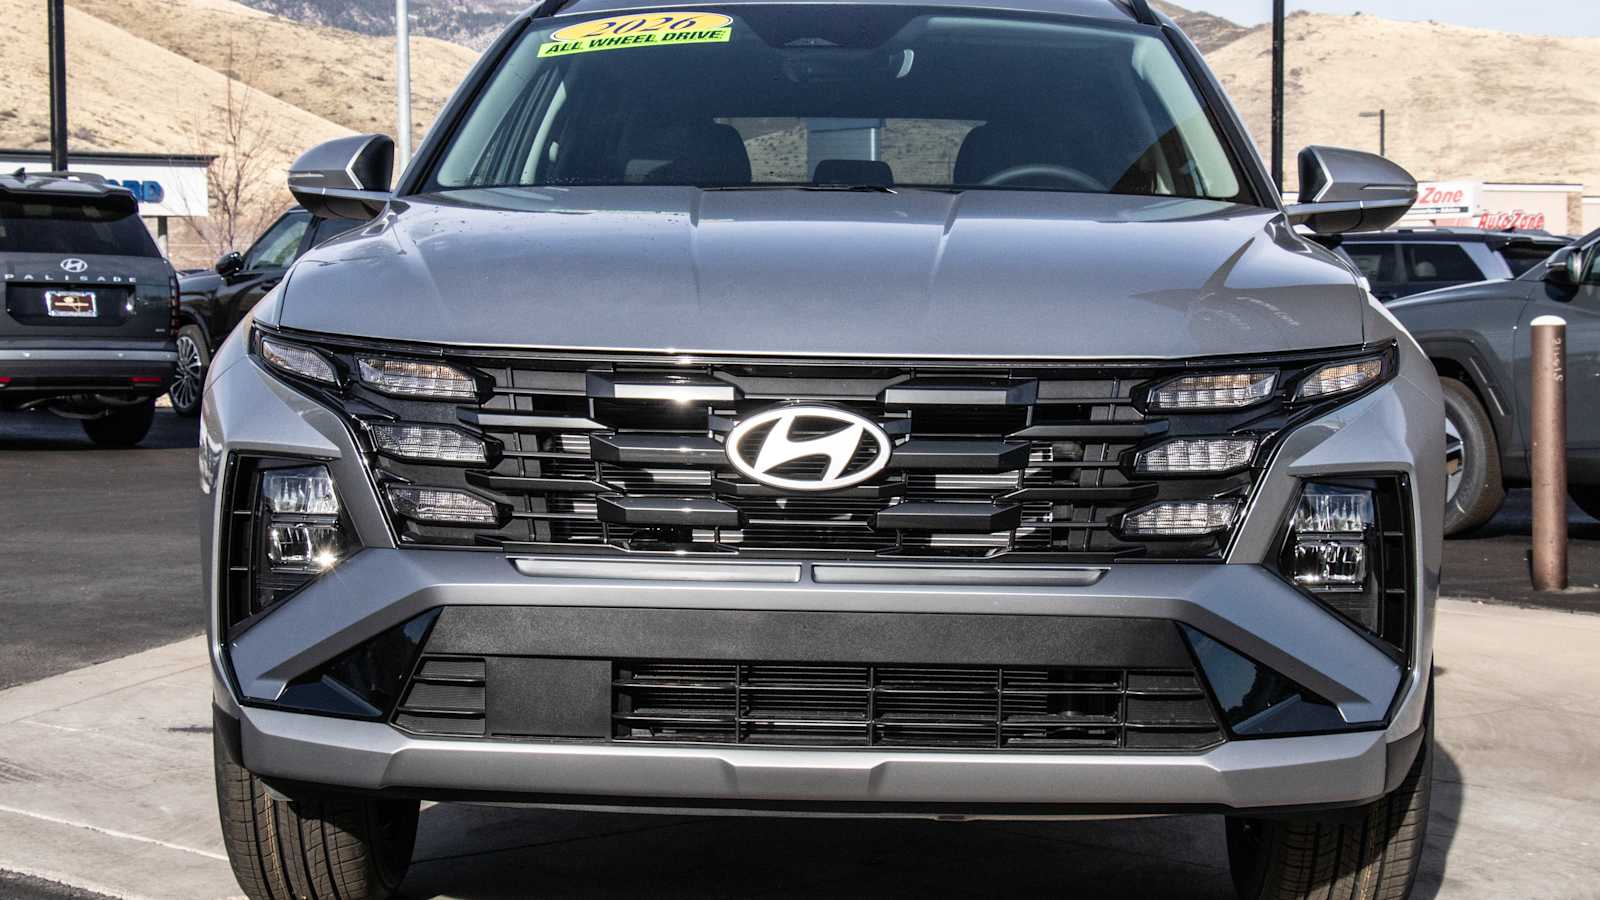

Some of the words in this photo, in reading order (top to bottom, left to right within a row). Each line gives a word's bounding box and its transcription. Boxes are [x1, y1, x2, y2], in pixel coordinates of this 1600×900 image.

[582, 17, 700, 37] 2026
[545, 42, 583, 54] ALL
[588, 34, 656, 48] WHEEL
[661, 30, 723, 41] DRIVE
[105, 179, 164, 203] RD
[1416, 187, 1463, 204] Zone
[4, 273, 137, 283] PALISADE
